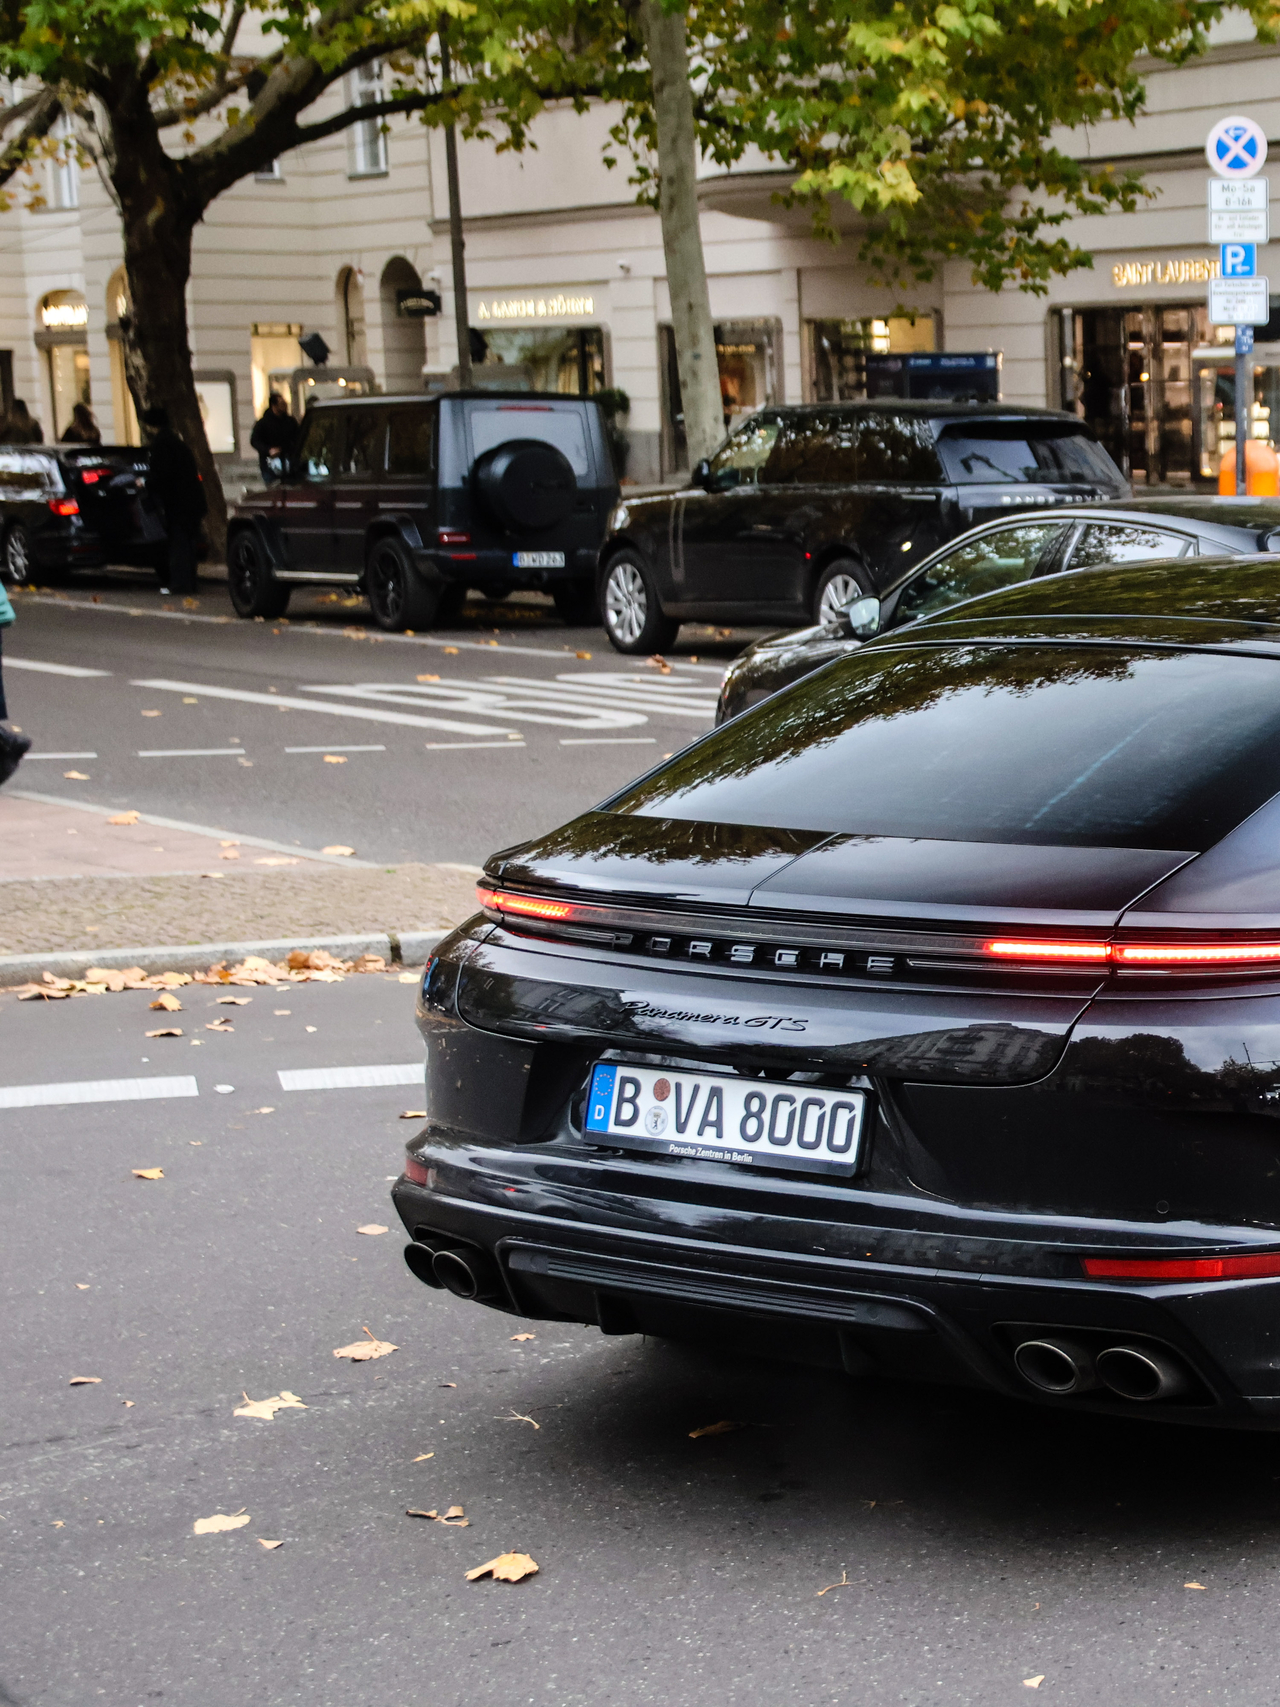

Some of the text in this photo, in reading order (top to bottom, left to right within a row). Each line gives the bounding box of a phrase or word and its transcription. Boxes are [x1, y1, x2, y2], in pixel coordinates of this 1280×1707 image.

[1112, 261, 1154, 287] SAINT
[1226, 245, 1246, 274] P
[613, 932, 895, 974] PORSCHE
[620, 1000, 809, 1032] Panamera GTS
[594, 1104, 604, 1120] D
[614, 1075, 857, 1154] B VA 8000
[669, 1143, 753, 1163] Porsche Zentren in Berlin
